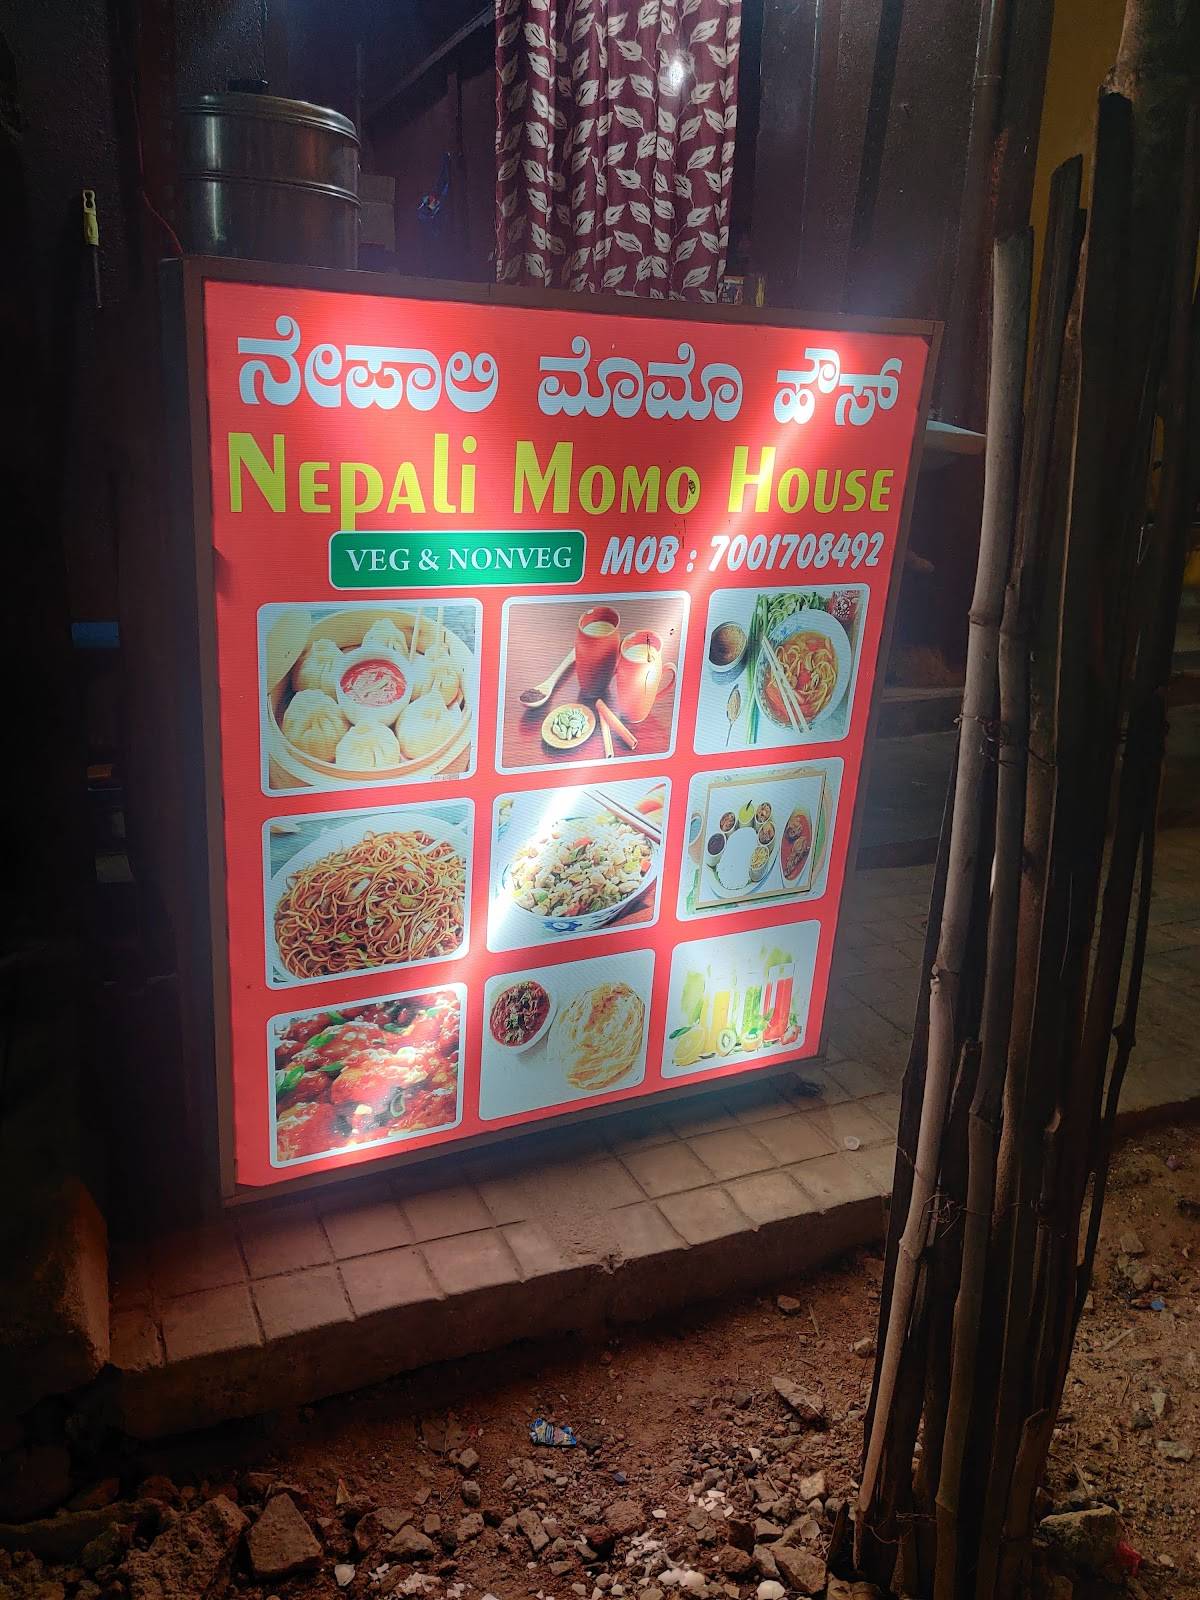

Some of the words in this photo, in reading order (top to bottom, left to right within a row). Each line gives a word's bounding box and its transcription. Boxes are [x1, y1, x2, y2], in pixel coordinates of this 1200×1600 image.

[237, 315, 499, 413] ನೇಪಾಲಿ
[773, 347, 903, 426] ಹೌಸ್
[345, 548, 410, 572] VEG
[418, 548, 440, 571] &
[447, 546, 573, 571] NONVEG
[600, 535, 681, 575] MOB
[707, 531, 885, 573] 7001708492
